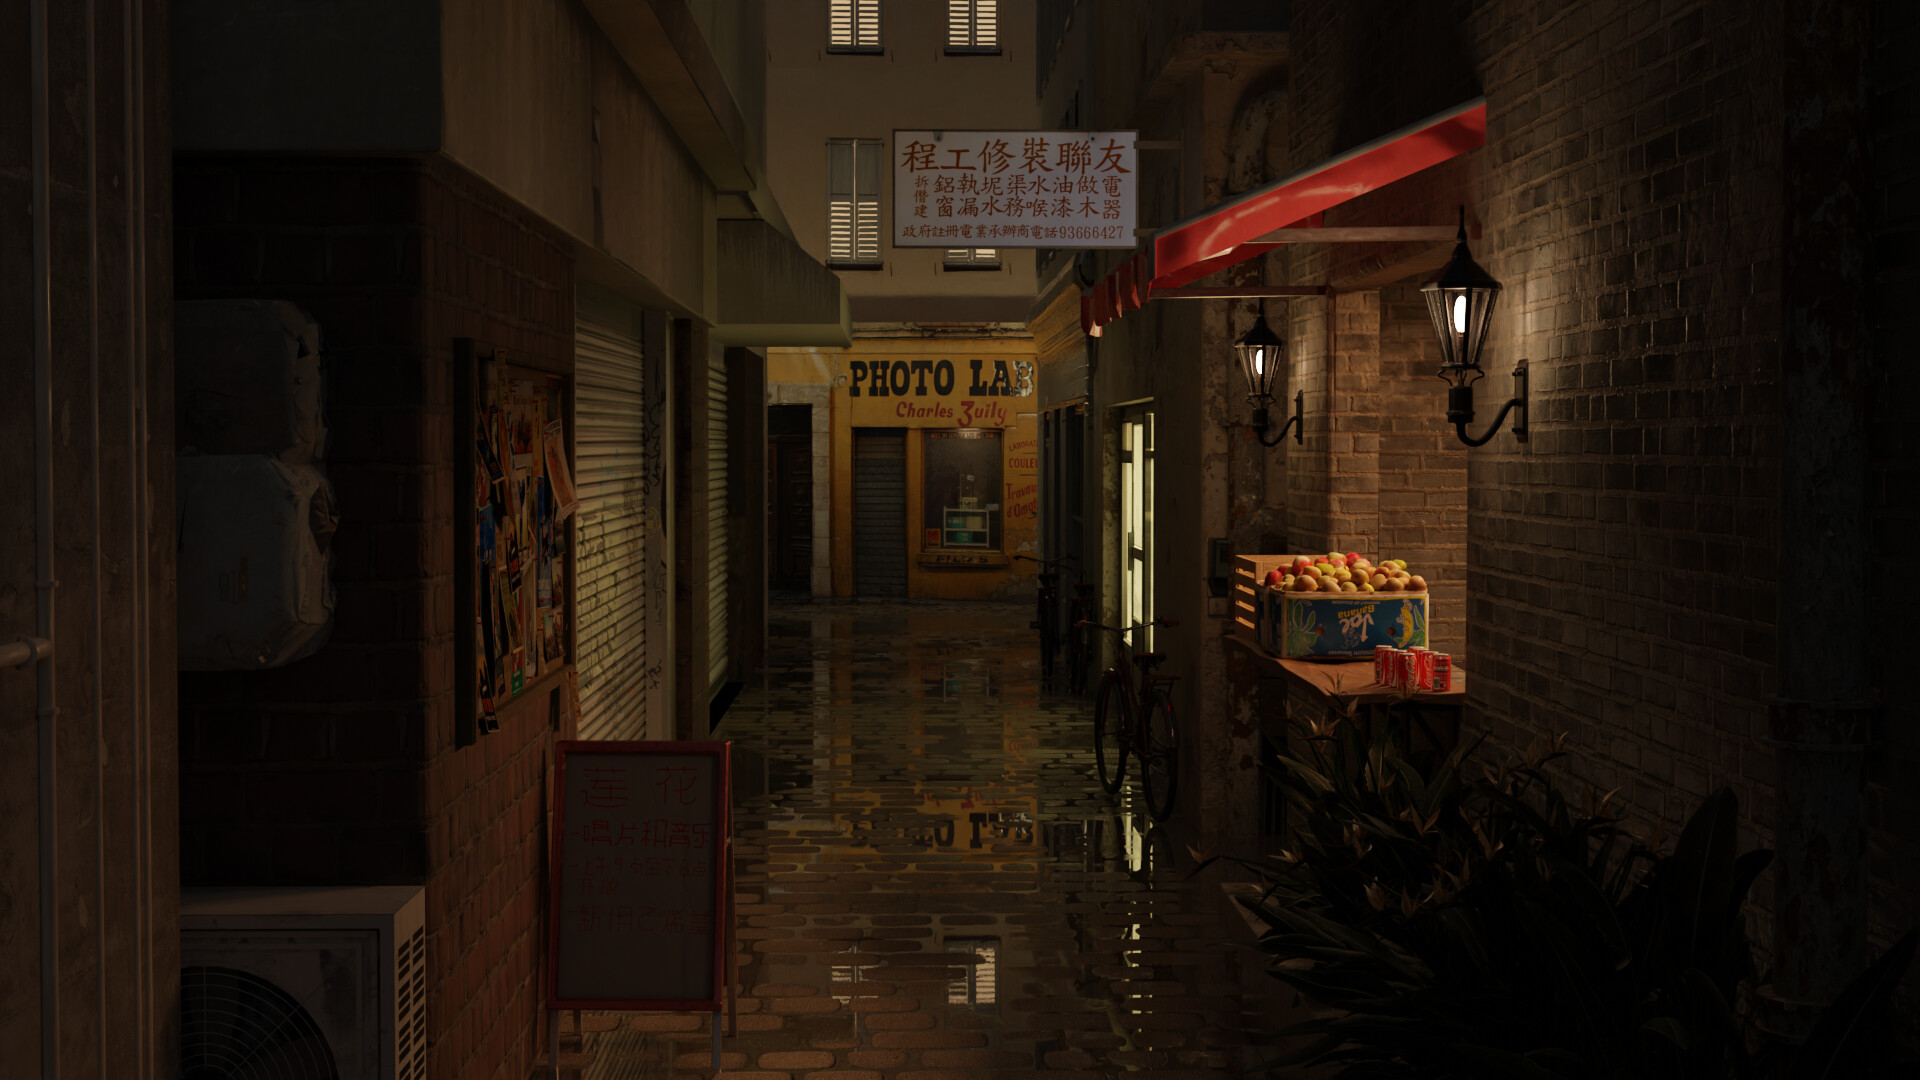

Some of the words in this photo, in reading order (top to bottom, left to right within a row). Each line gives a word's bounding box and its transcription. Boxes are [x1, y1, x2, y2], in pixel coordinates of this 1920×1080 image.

[849, 360, 955, 397] PHOTO
[969, 360, 1034, 397] LAB
[896, 401, 954, 418] Charles
[1337, 604, 1375, 619] Banana
[1338, 613, 1375, 643] Joe
